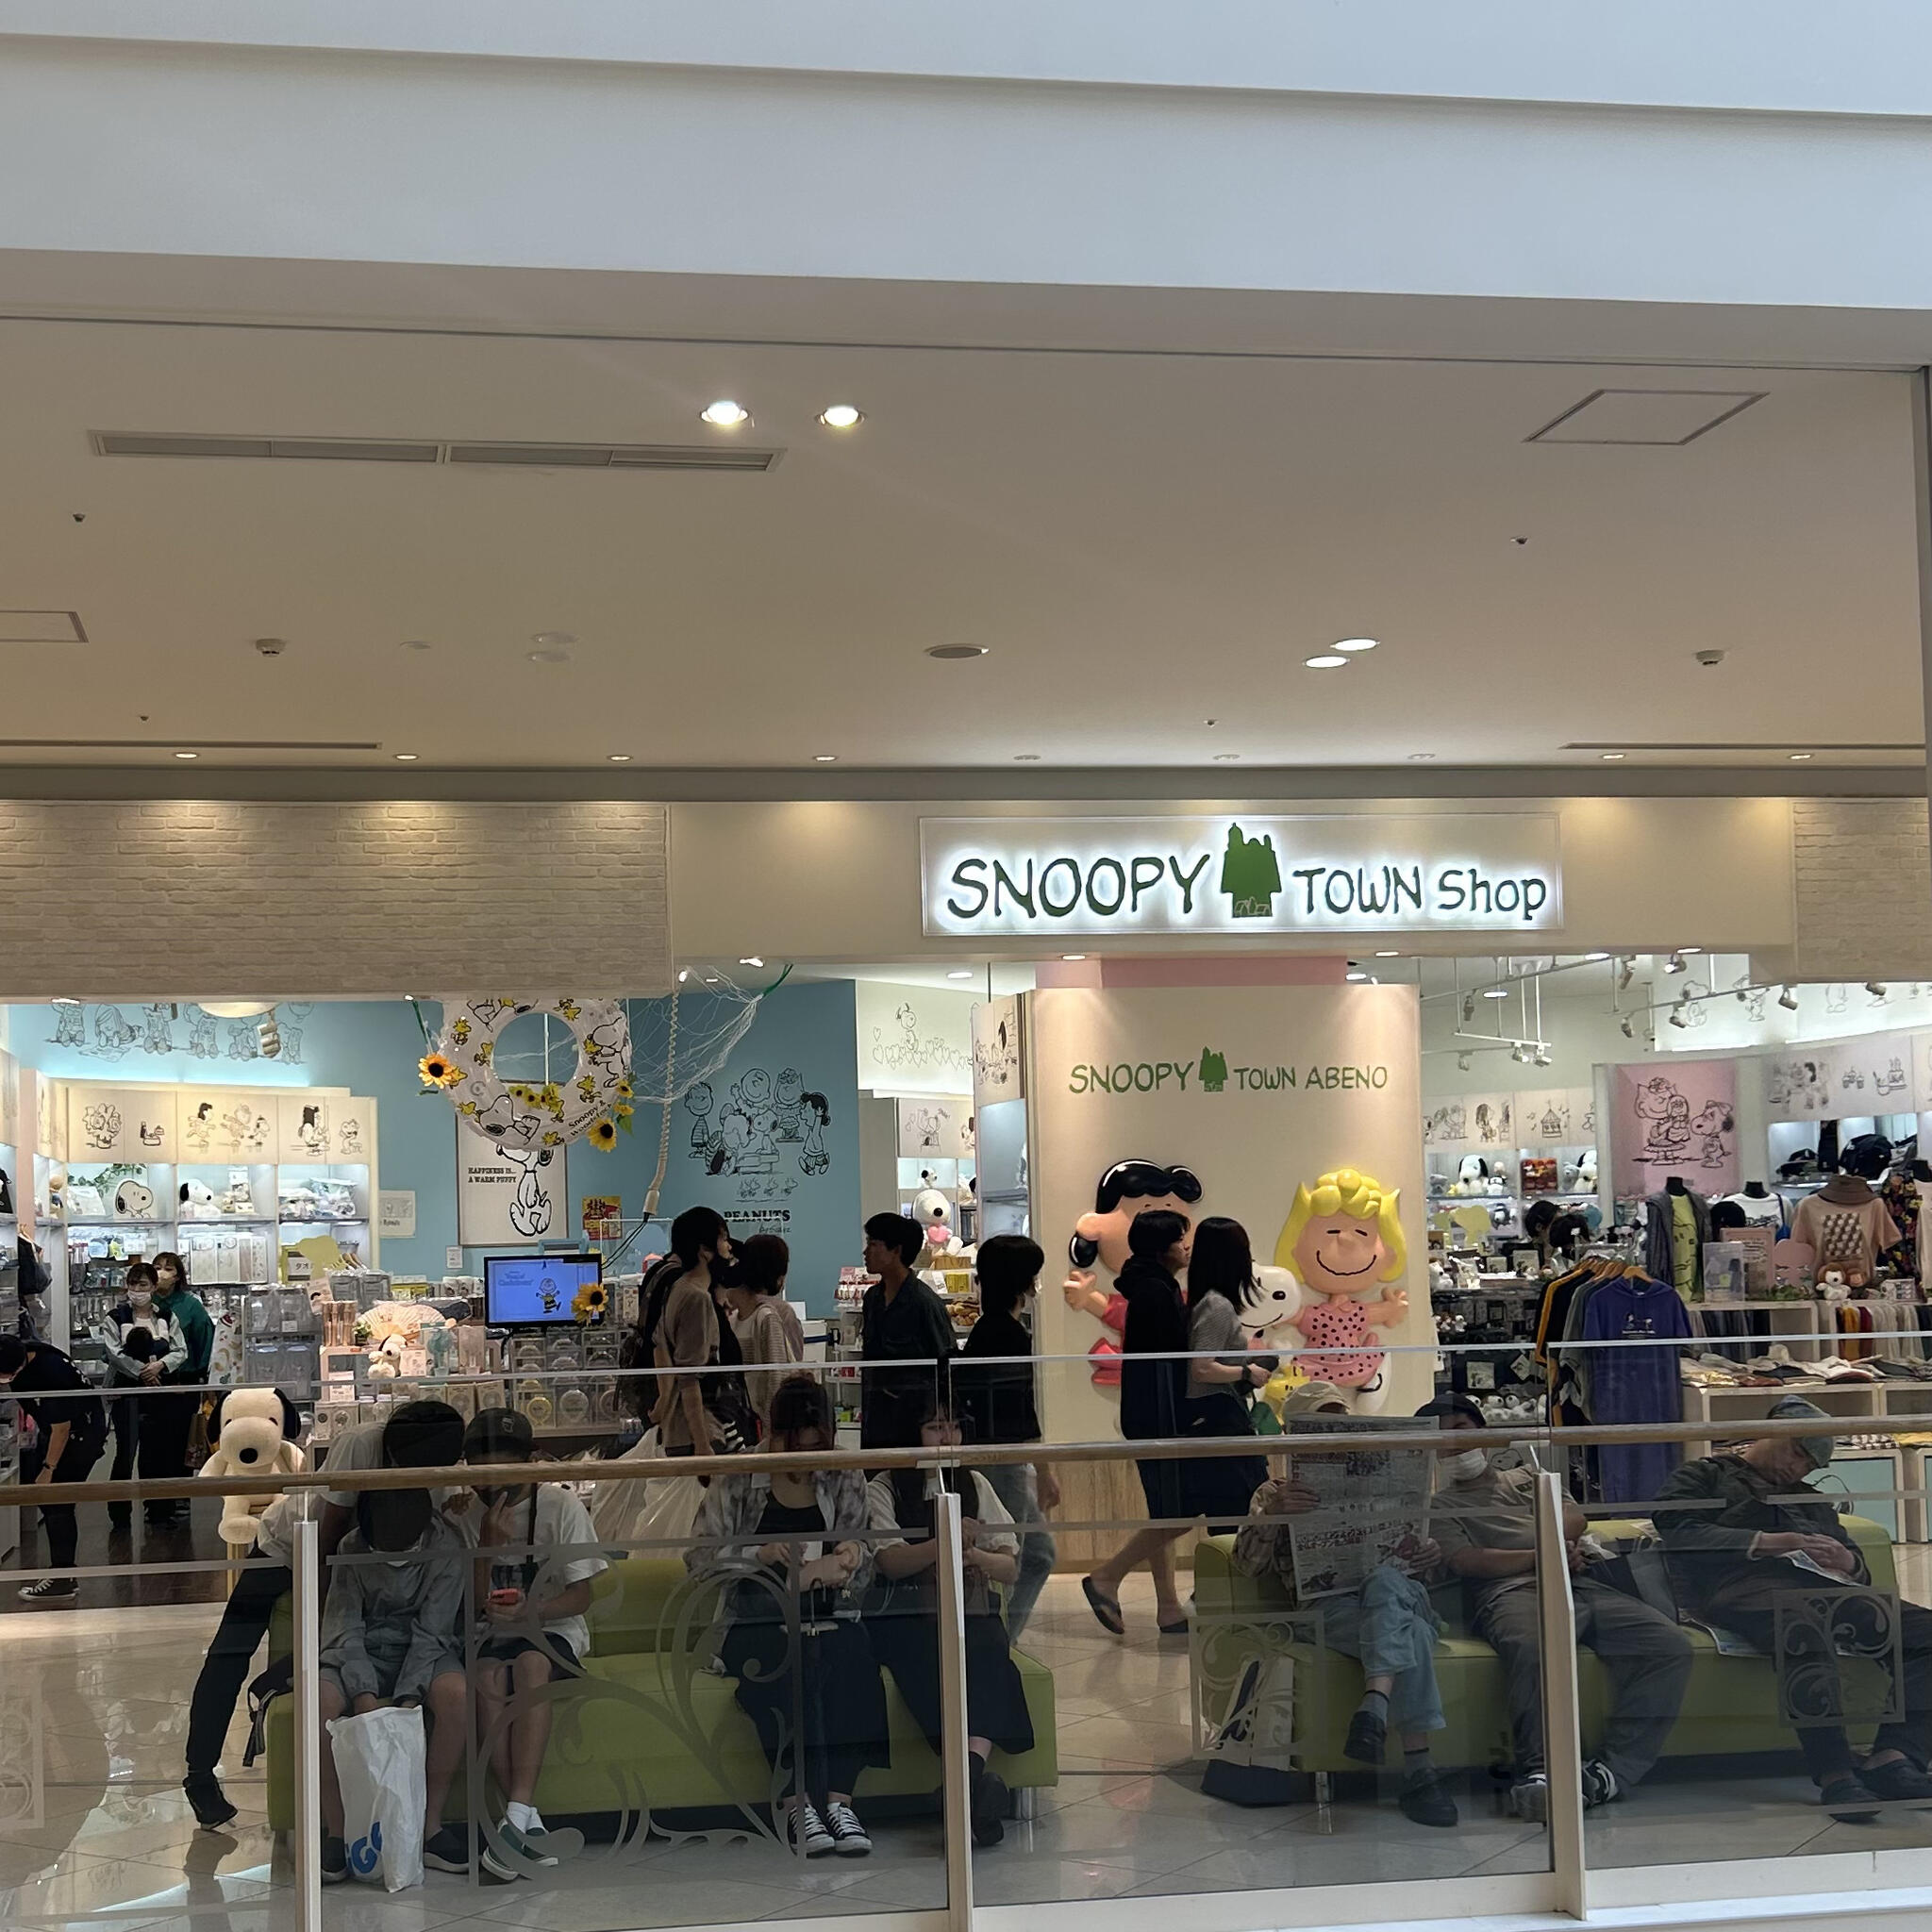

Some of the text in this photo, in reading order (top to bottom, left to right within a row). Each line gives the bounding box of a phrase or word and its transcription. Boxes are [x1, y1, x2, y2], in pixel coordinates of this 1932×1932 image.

[948, 855, 1546, 922] SNOOPY TOWN Shop
[1069, 1060, 1388, 1094] SNOOPY TOWN ABENO
[568, 1106, 598, 1127] Snoopy
[724, 1209, 791, 1224] PEANUTS
